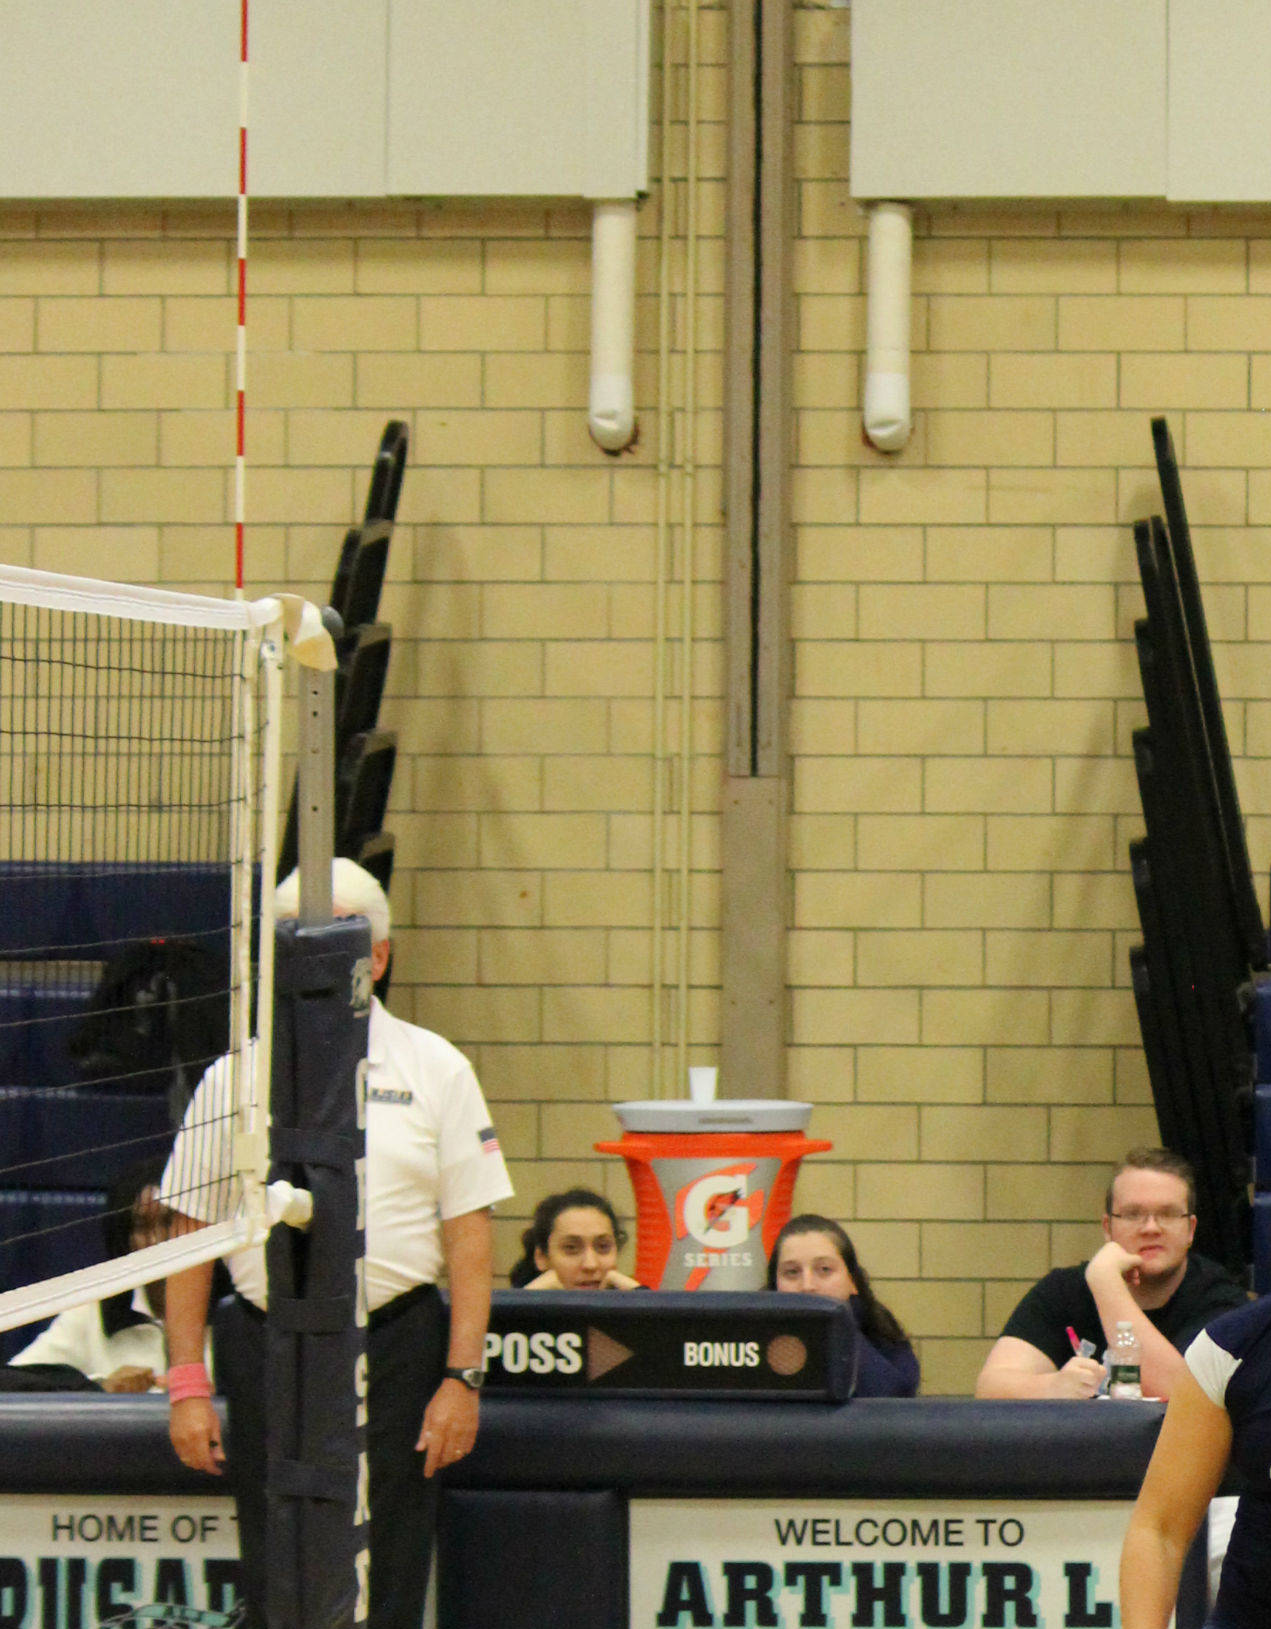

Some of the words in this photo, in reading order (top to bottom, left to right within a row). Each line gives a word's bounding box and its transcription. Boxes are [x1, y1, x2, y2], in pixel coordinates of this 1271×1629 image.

[683, 1174, 749, 1248] G
[683, 1252, 753, 1268] SERIES
[481, 1332, 582, 1374] POSS
[683, 1341, 760, 1367] BONUS
[52, 1514, 159, 1542] HOME
[171, 1514, 219, 1543] OF
[774, 1518, 965, 1546] WELCOME
[975, 1518, 1025, 1546] TO
